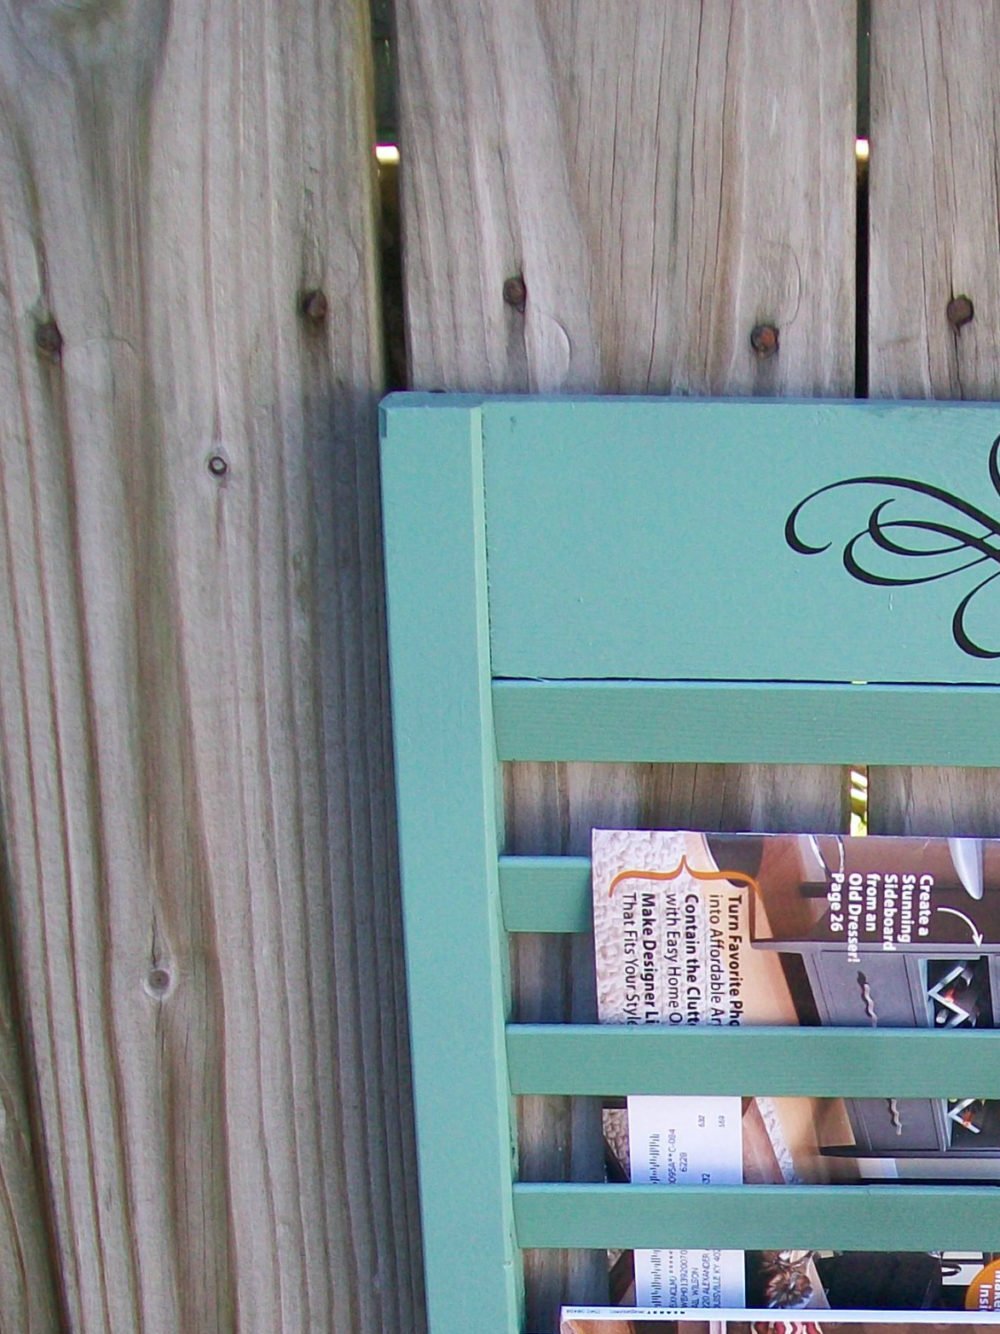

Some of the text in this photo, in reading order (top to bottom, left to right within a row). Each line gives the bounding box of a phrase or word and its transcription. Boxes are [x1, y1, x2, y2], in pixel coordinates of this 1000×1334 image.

[622, 892, 637, 926] That
[641, 892, 657, 936] Make
[666, 893, 680, 926] with
[709, 894, 724, 925] into
[827, 872, 845, 932] Page 26
[847, 872, 862, 963] Old Dresser!
[865, 873, 881, 932] from an
[883, 873, 899, 951] Sideboard
[897, 874, 916, 943] Stunning
[918, 874, 934, 937] Create a
[624, 930, 639, 955] Fits
[663, 931, 681, 963] Easy
[684, 893, 701, 1026] Contain the Clutt
[709, 928, 725, 1004] Affordable
[728, 894, 744, 1027] Turn Favorite Pho
[624, 958, 640, 990] Your
[640, 940, 658, 1007] Designer
[668, 966, 681, 1008] Home
